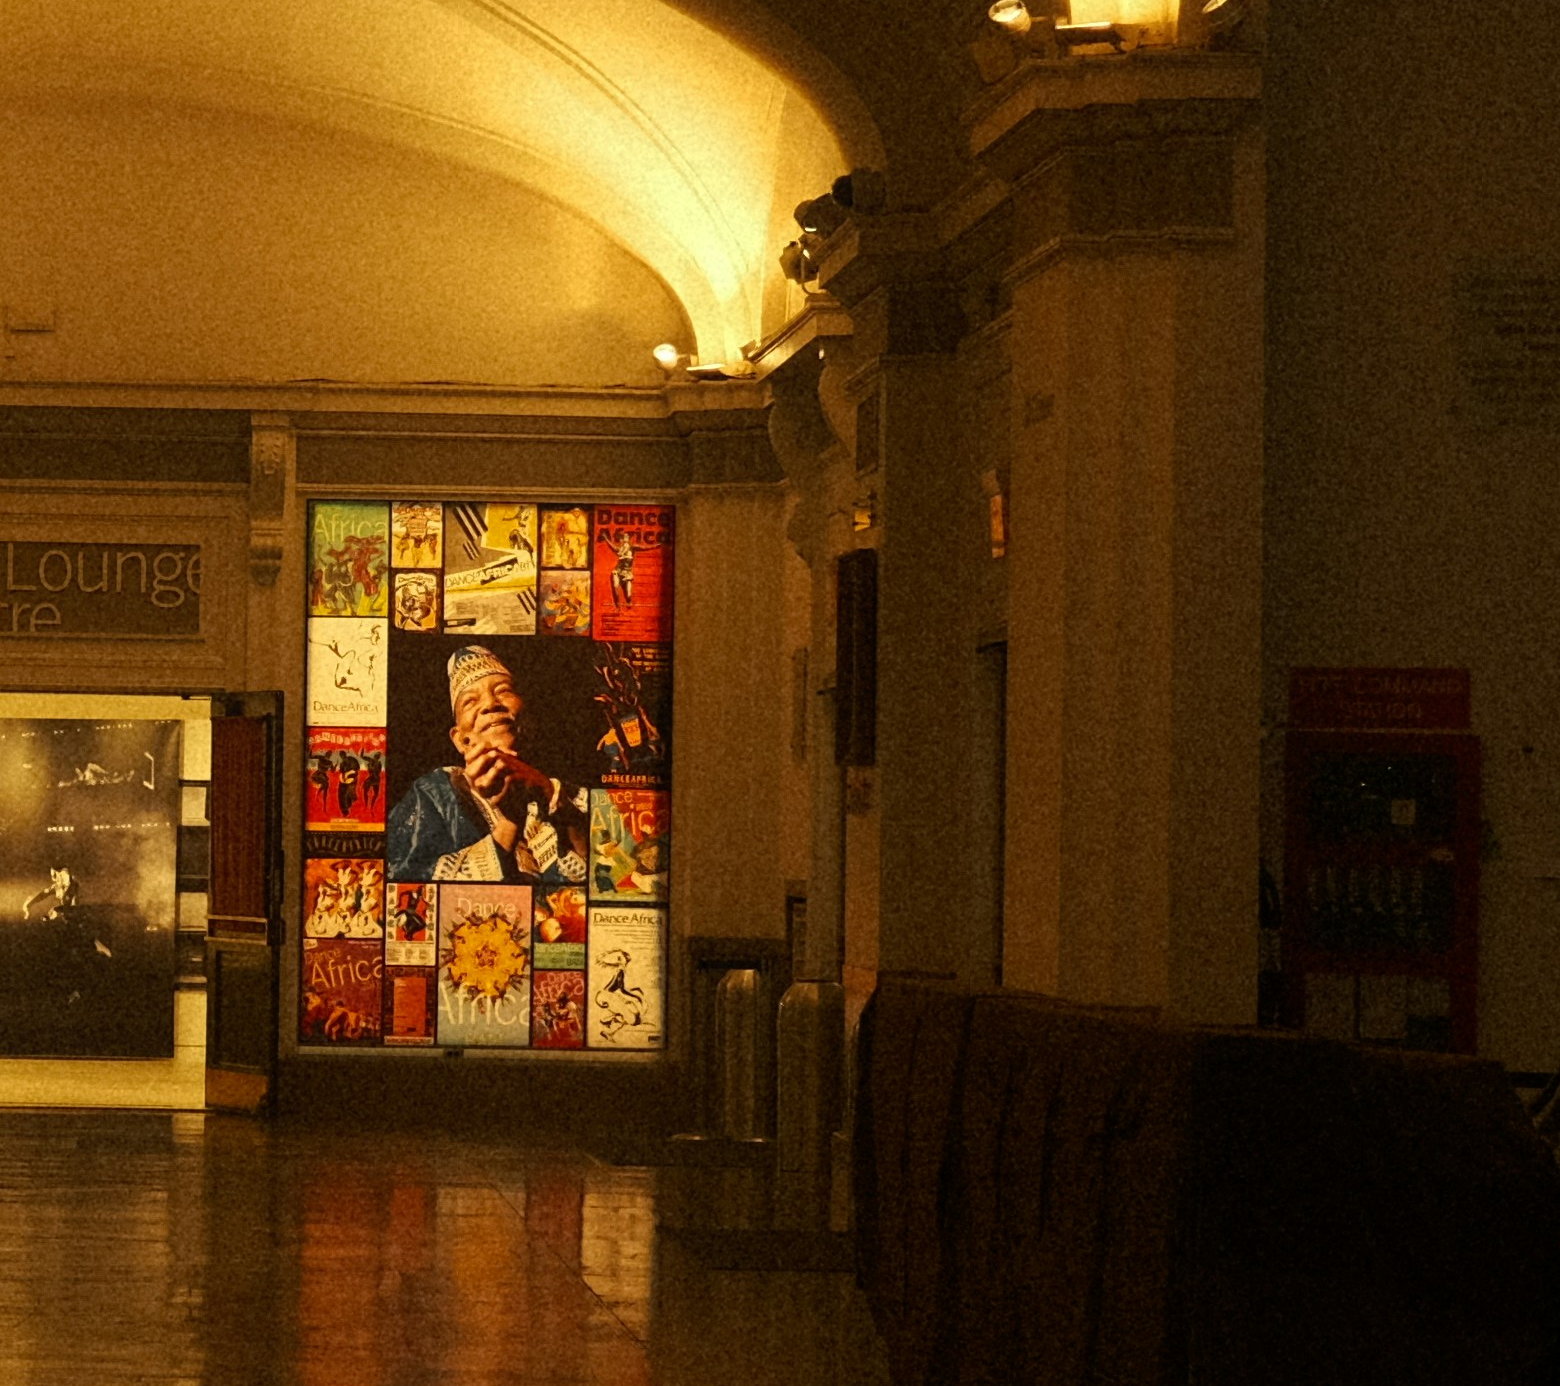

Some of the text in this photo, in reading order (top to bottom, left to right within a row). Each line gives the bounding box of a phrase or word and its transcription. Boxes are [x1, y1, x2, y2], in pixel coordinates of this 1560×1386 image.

[598, 509, 671, 526] Dance
[311, 513, 389, 544] Africa
[597, 527, 671, 544] Africa
[457, 897, 517, 918] Dance
[312, 955, 382, 989] Africa
